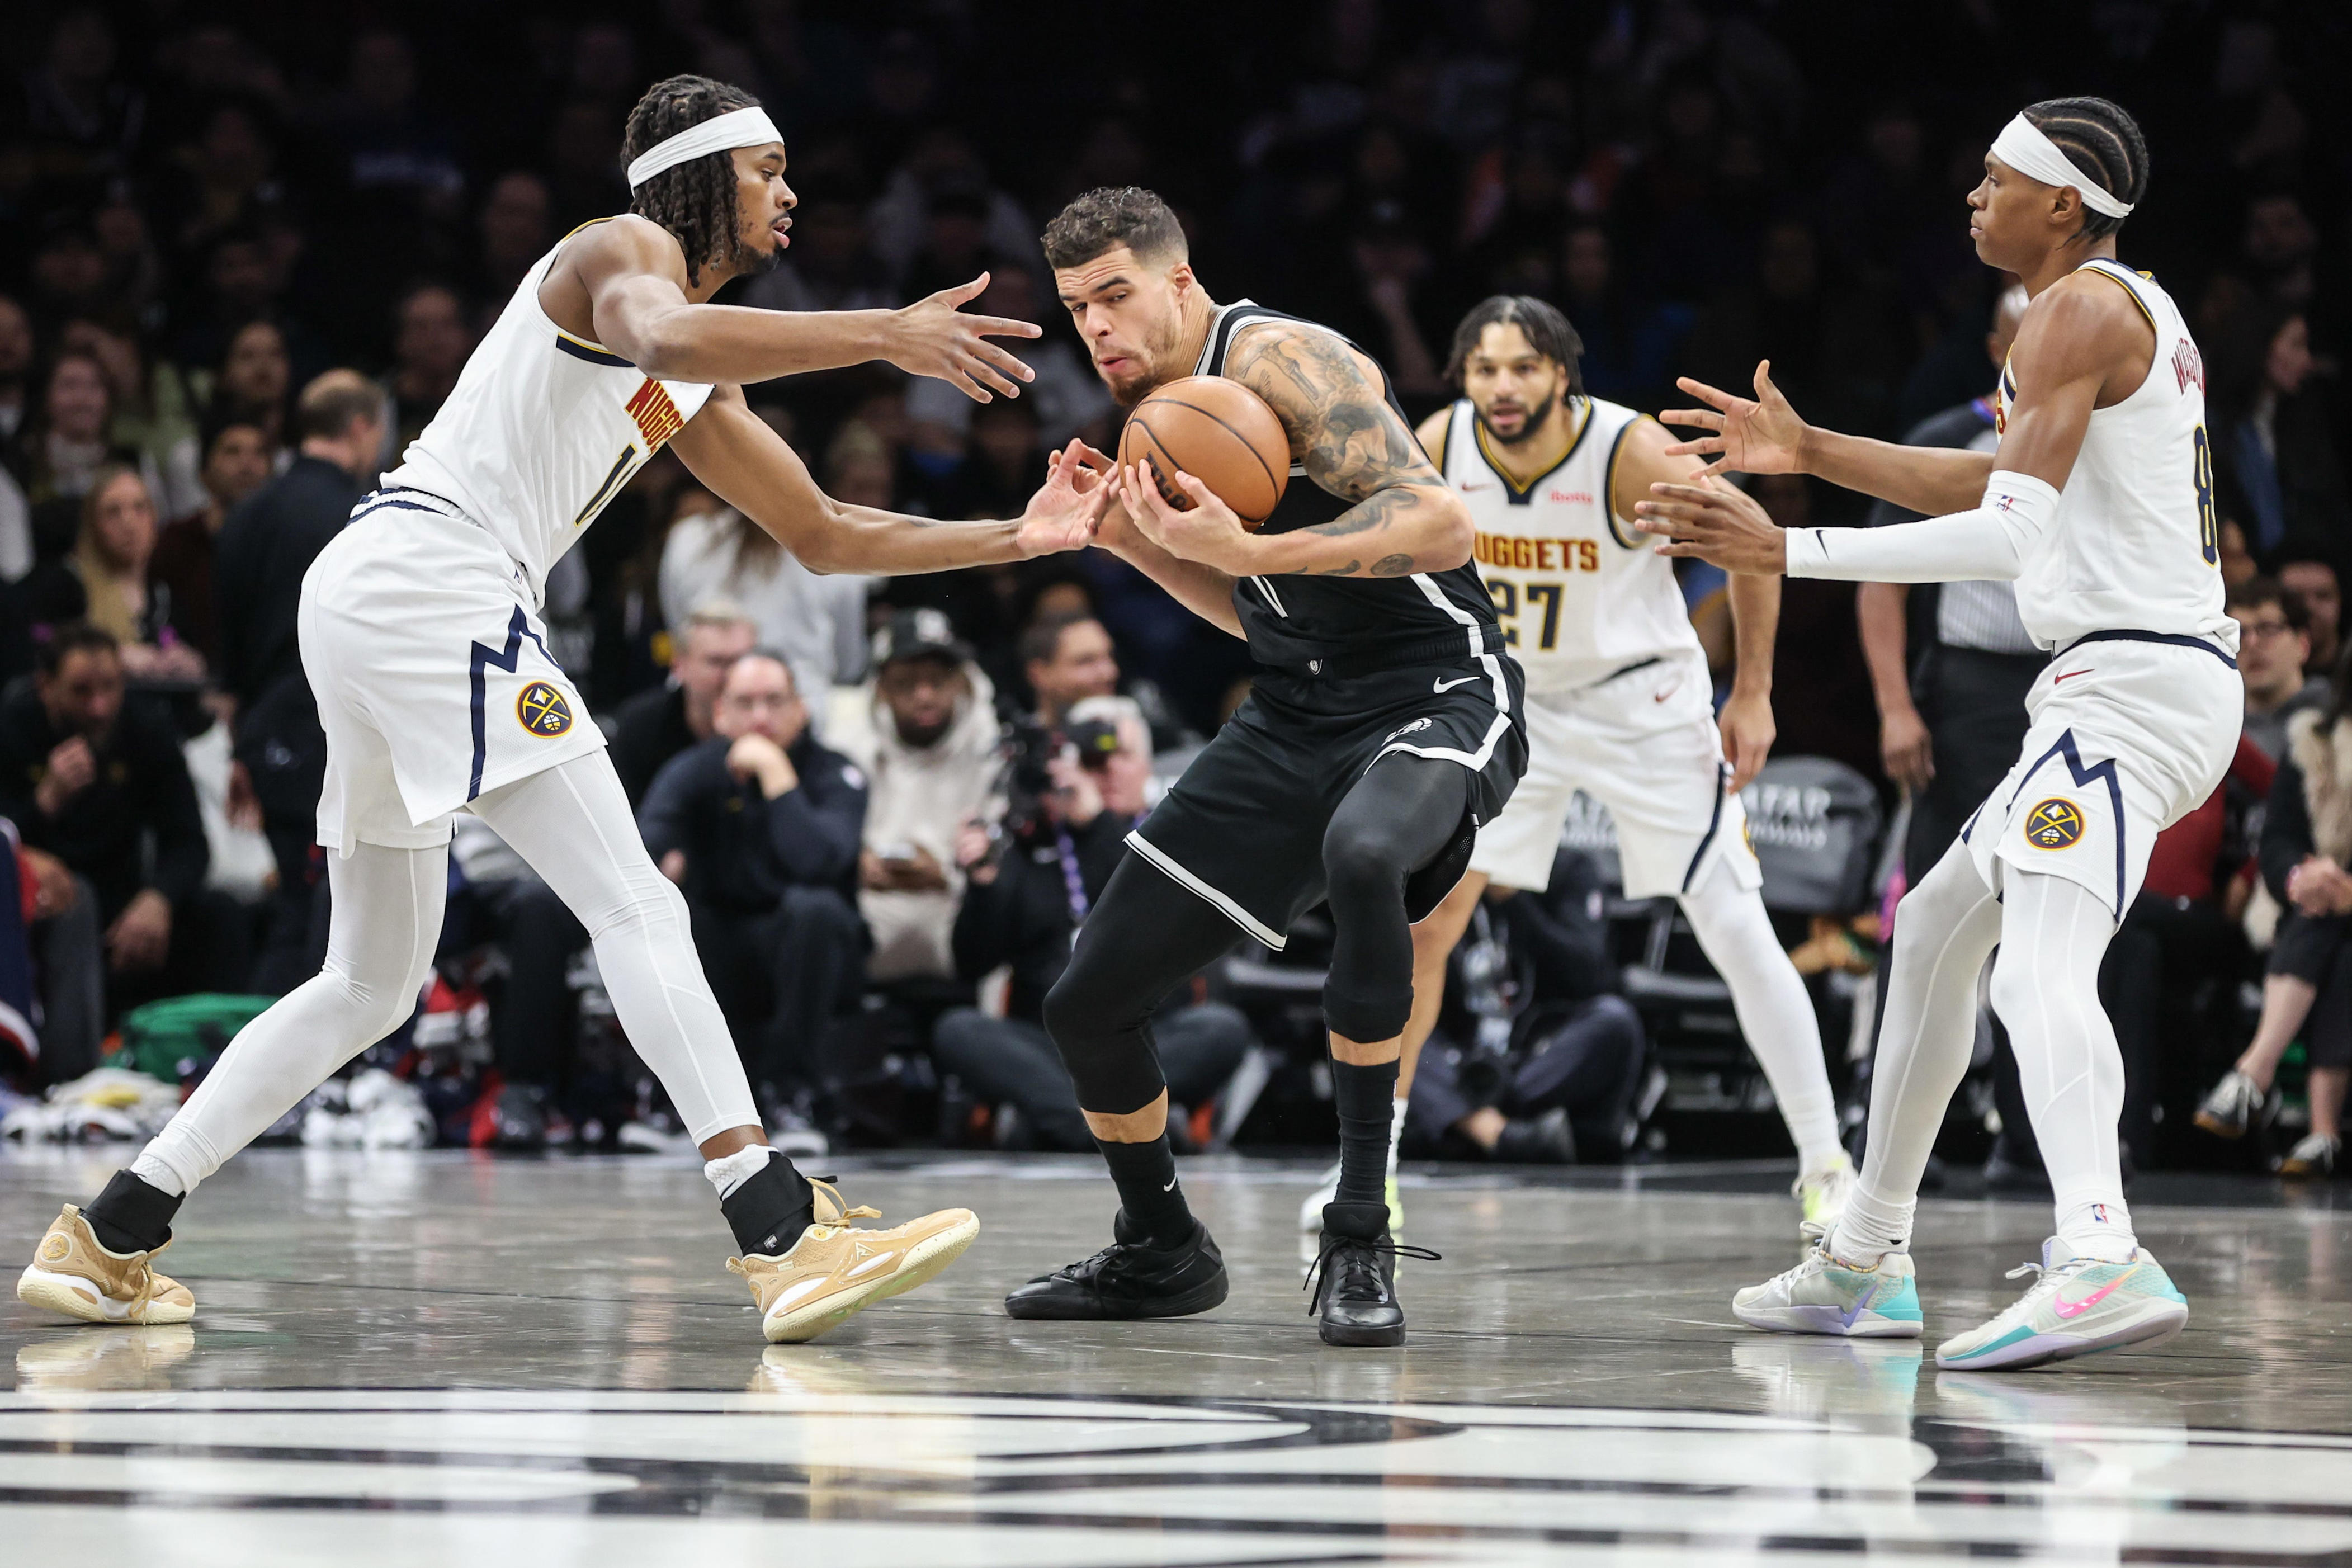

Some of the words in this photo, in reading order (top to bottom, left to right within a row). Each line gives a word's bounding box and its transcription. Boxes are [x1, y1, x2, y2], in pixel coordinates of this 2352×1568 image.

[2194, 423, 2218, 568] 8
[1473, 532, 1599, 572] UGGETS
[1485, 578, 1565, 650] 27
